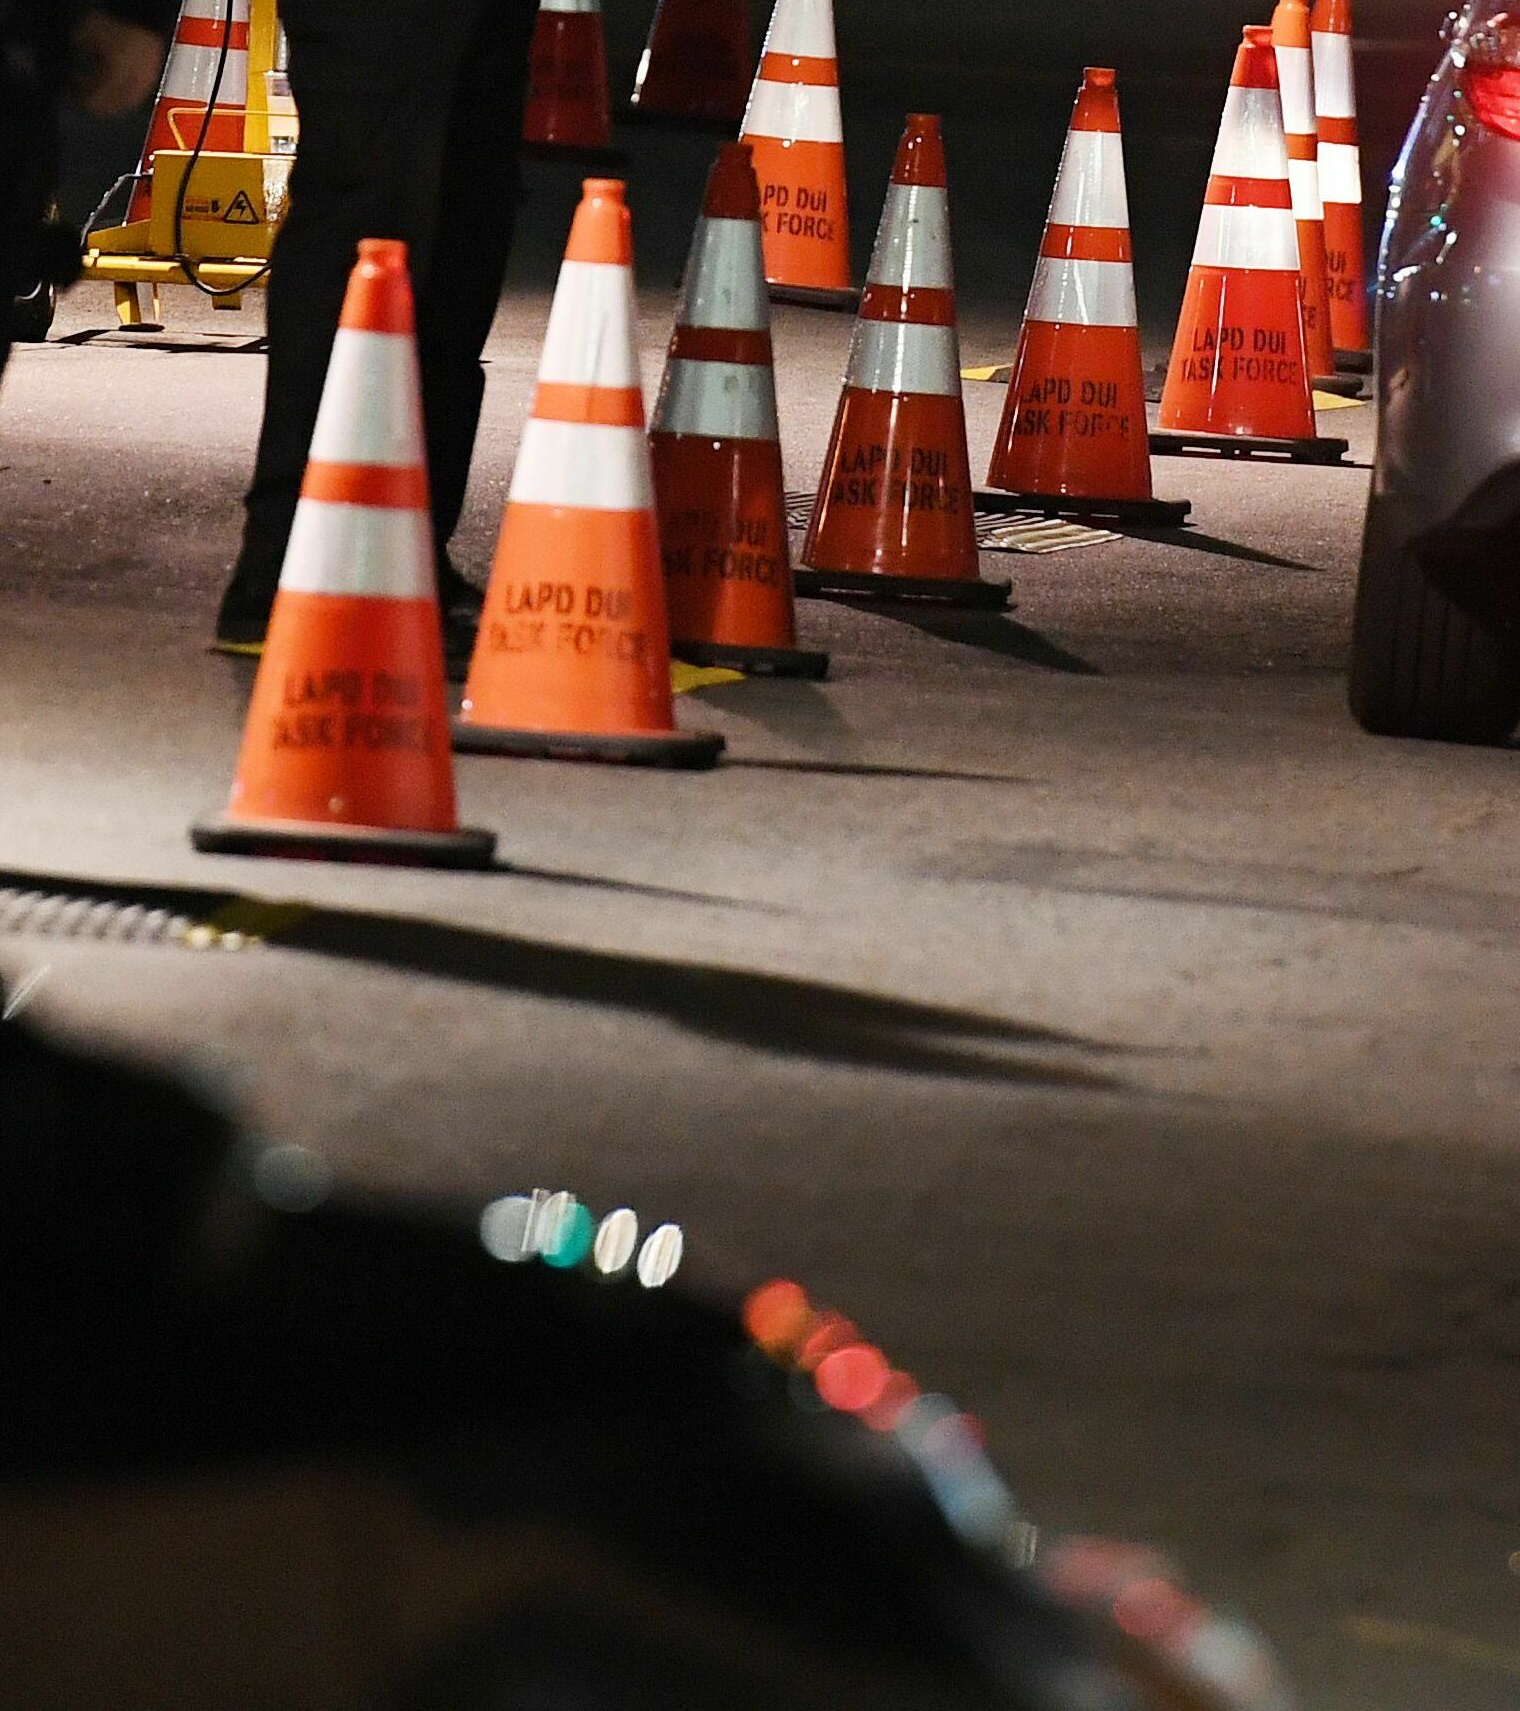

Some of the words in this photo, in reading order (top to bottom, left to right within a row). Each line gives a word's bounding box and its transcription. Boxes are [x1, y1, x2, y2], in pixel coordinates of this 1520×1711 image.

[762, 184, 789, 207] PD
[796, 186, 827, 213] DUI
[1193, 327, 1244, 353] LAPD
[1253, 328, 1286, 354] DUI
[1233, 357, 1297, 386] FORCE
[1081, 380, 1117, 409] DUI
[911, 447, 947, 477] DUI
[505, 581, 575, 615] LAPD
